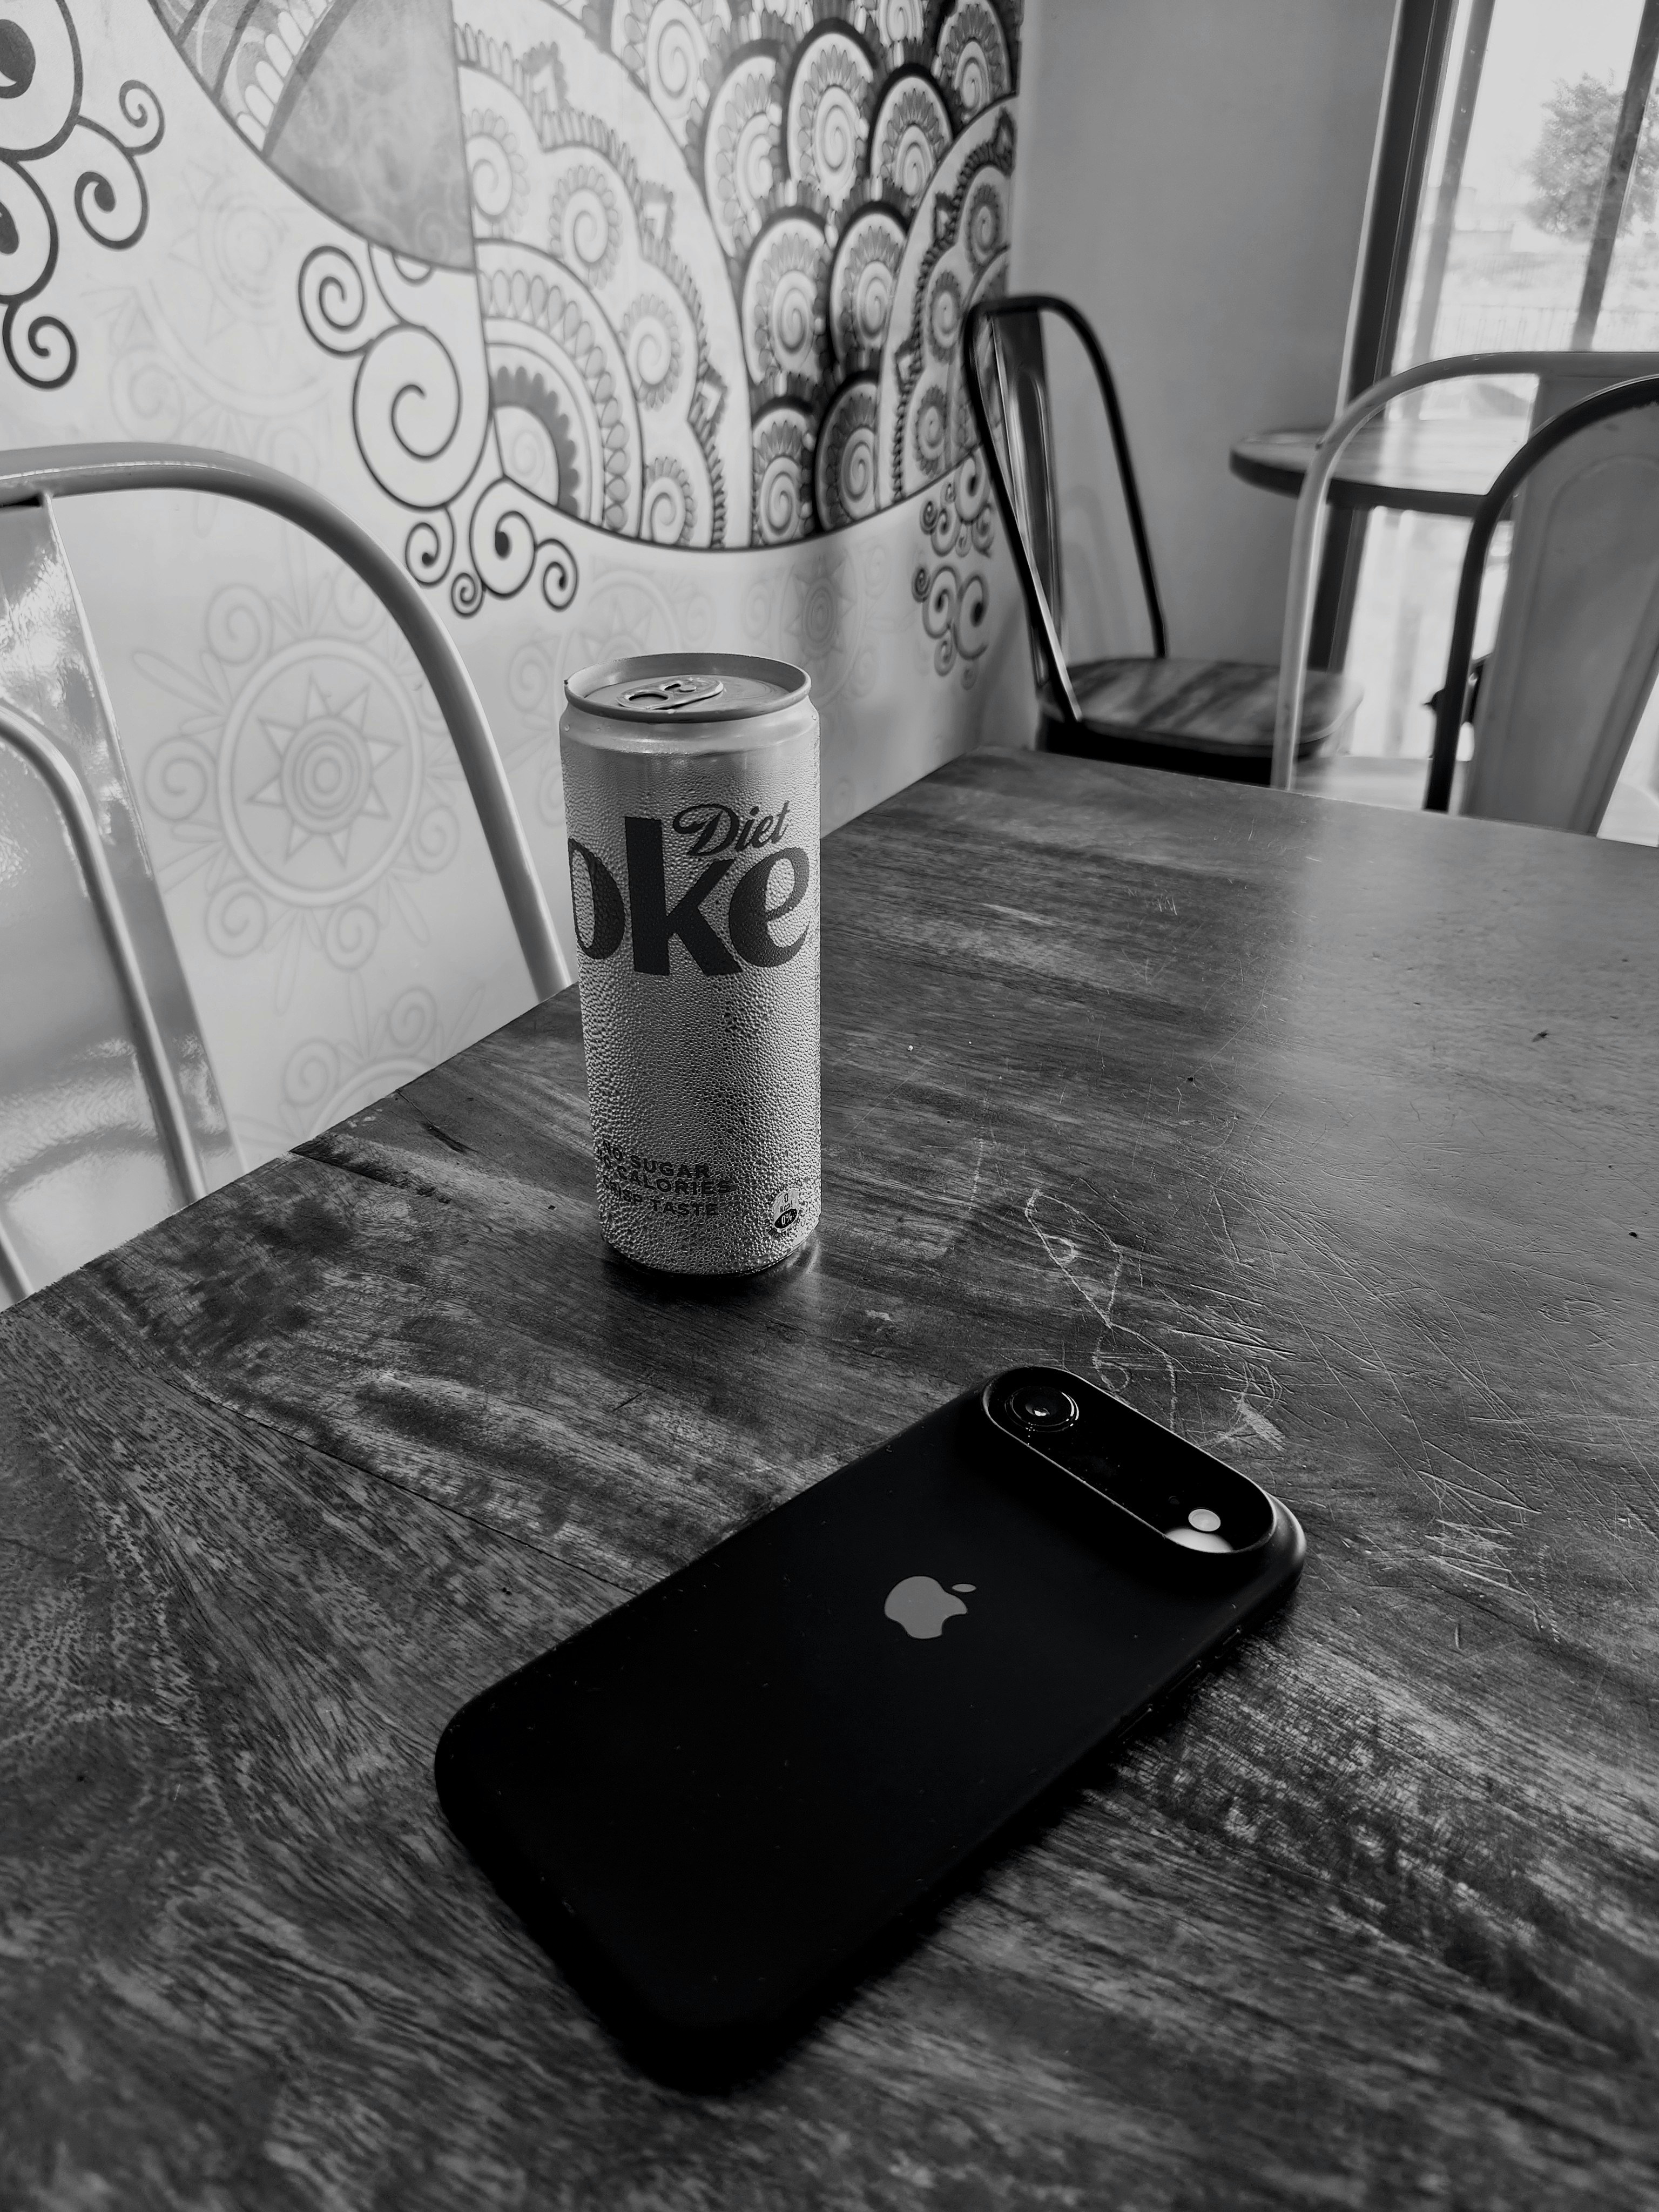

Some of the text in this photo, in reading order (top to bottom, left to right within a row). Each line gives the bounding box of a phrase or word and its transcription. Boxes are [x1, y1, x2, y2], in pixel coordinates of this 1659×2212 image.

[673, 800, 790, 857] Diet
[630, 1155, 711, 1178] SUGAR
[617, 1165, 733, 1195] CALORIES
[650, 1198, 719, 1216] TASTE
[781, 1211, 793, 1225] 0%
